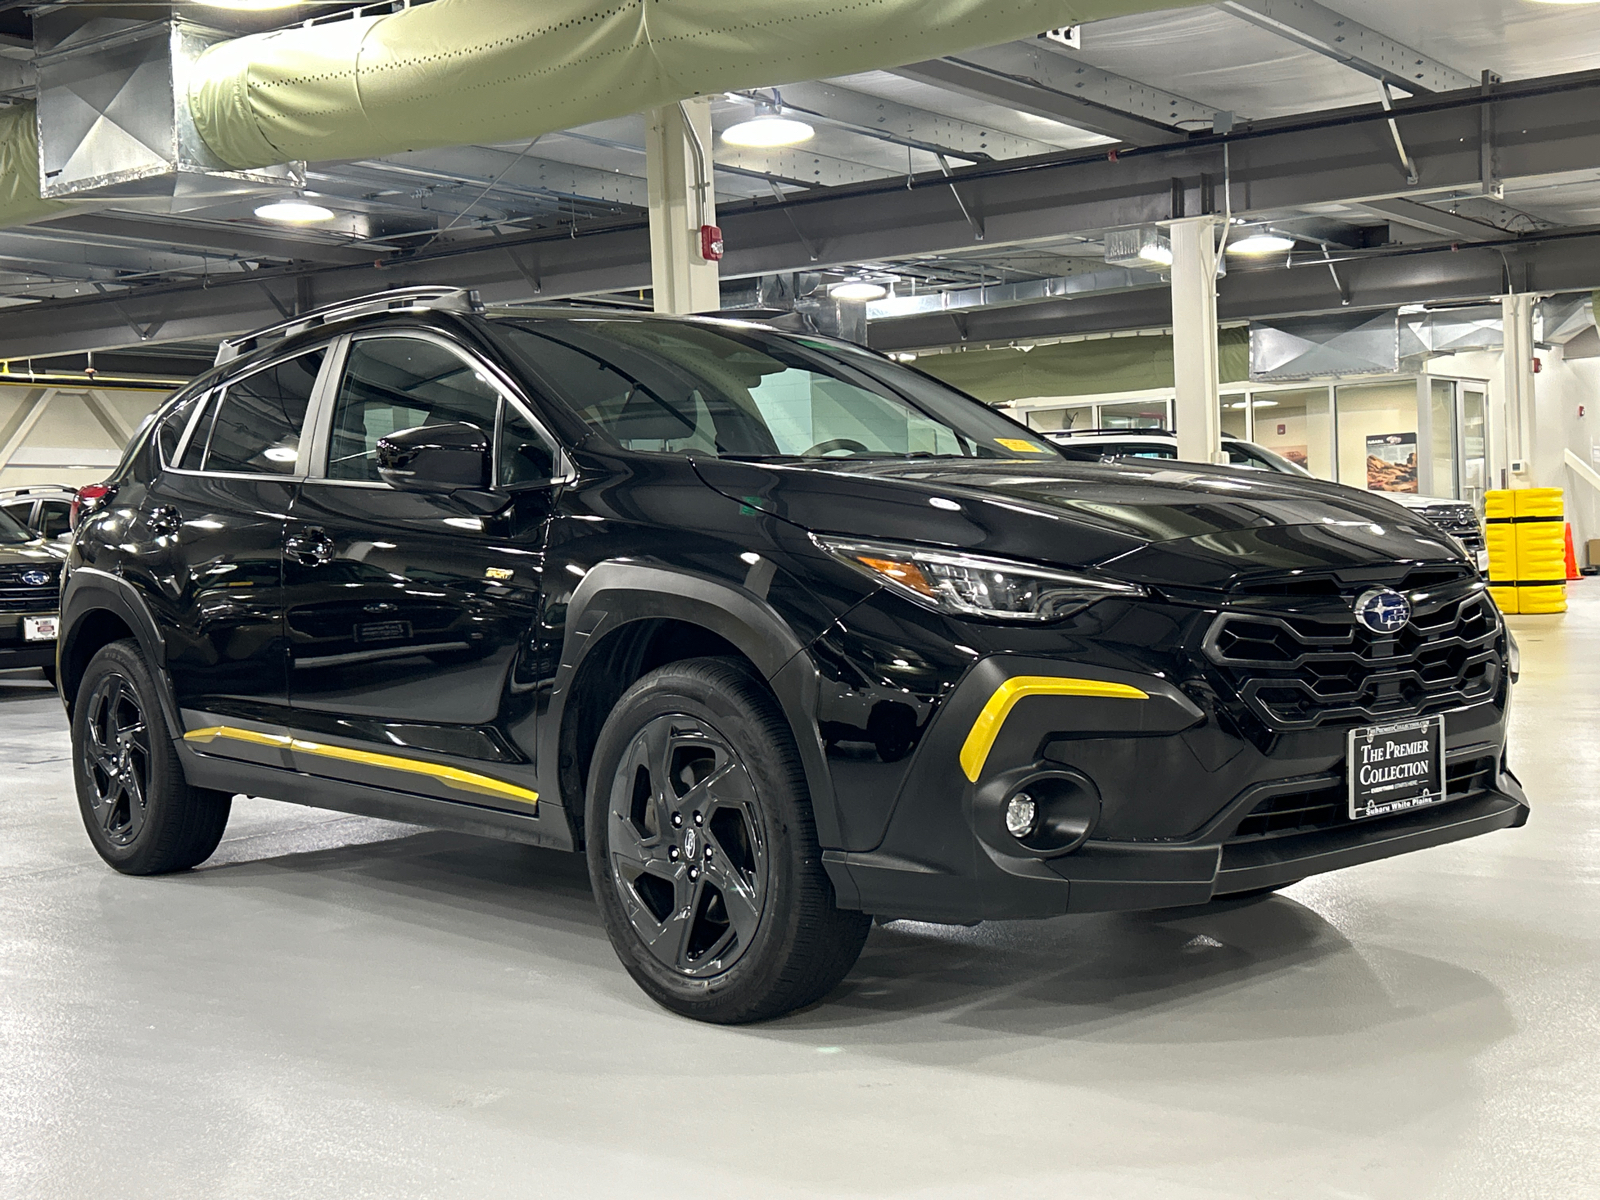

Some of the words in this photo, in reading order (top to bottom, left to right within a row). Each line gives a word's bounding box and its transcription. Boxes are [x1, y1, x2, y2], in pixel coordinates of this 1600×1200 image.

[1361, 744, 1384, 763] THE
[1385, 740, 1429, 759] PREMIER
[1360, 760, 1429, 785] COLLECTION
[1366, 806, 1390, 816] Subaru
[1391, 801, 1411, 810] White
[1412, 797, 1432, 806] Plains
